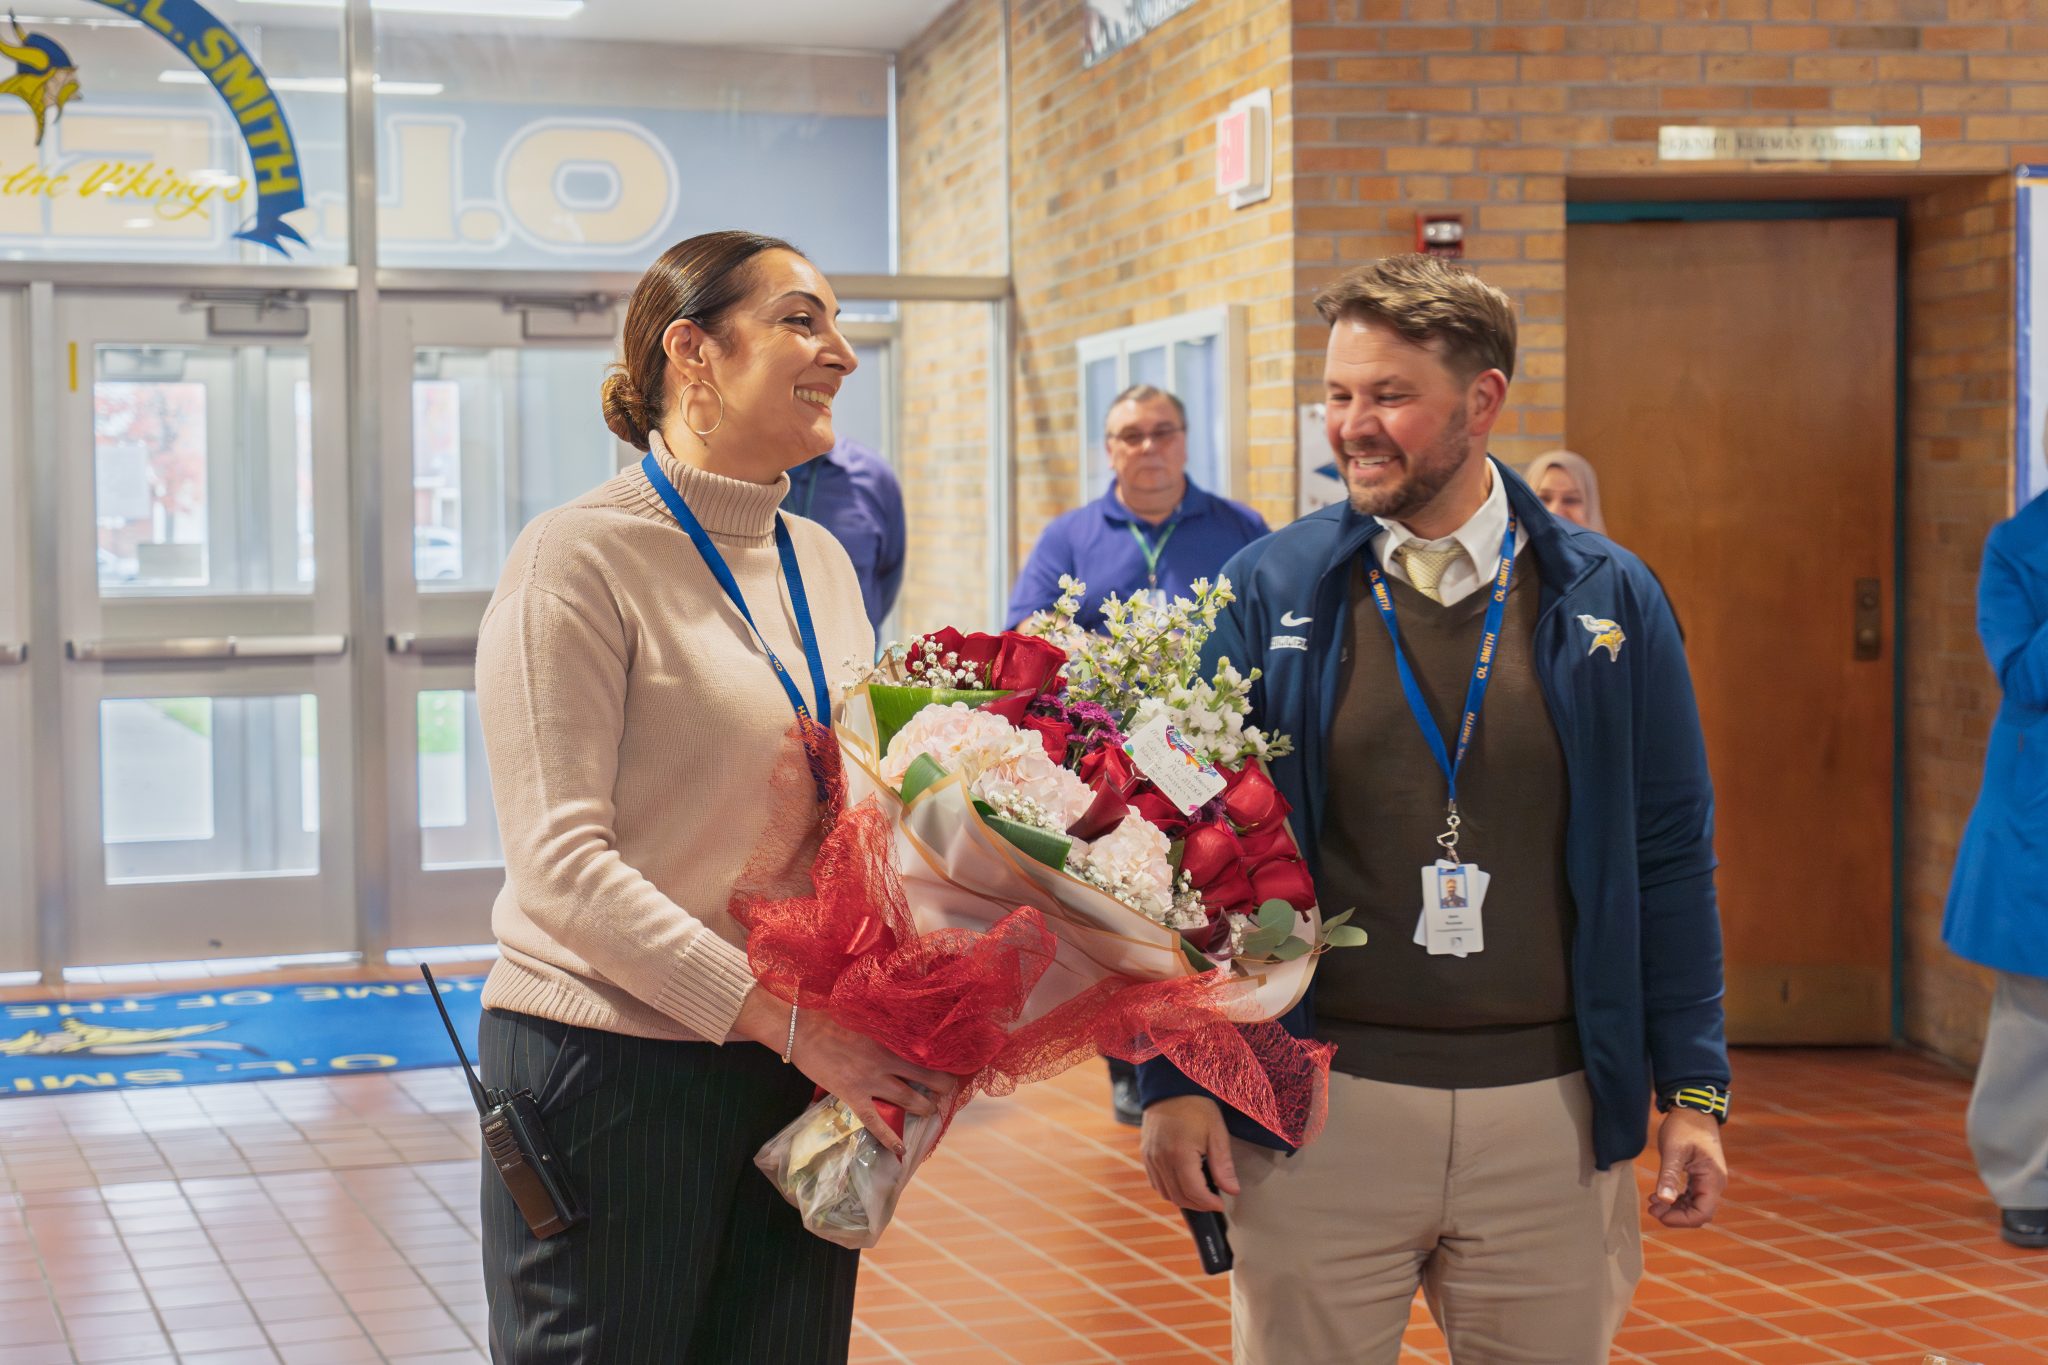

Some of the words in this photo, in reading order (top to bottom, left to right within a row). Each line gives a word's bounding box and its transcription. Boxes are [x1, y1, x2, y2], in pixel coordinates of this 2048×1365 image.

[103, 0, 184, 42] .L.
[188, 27, 300, 195] SMITH
[3, 163, 70, 197] the
[1497, 558, 1511, 587] SMITH
[1373, 582, 1393, 611] SMITH
[1480, 632, 1496, 664] SMITH
[1476, 665, 1489, 679] OL
[5, 1000, 156, 1020] THE
[176, 989, 274, 1010] OF
